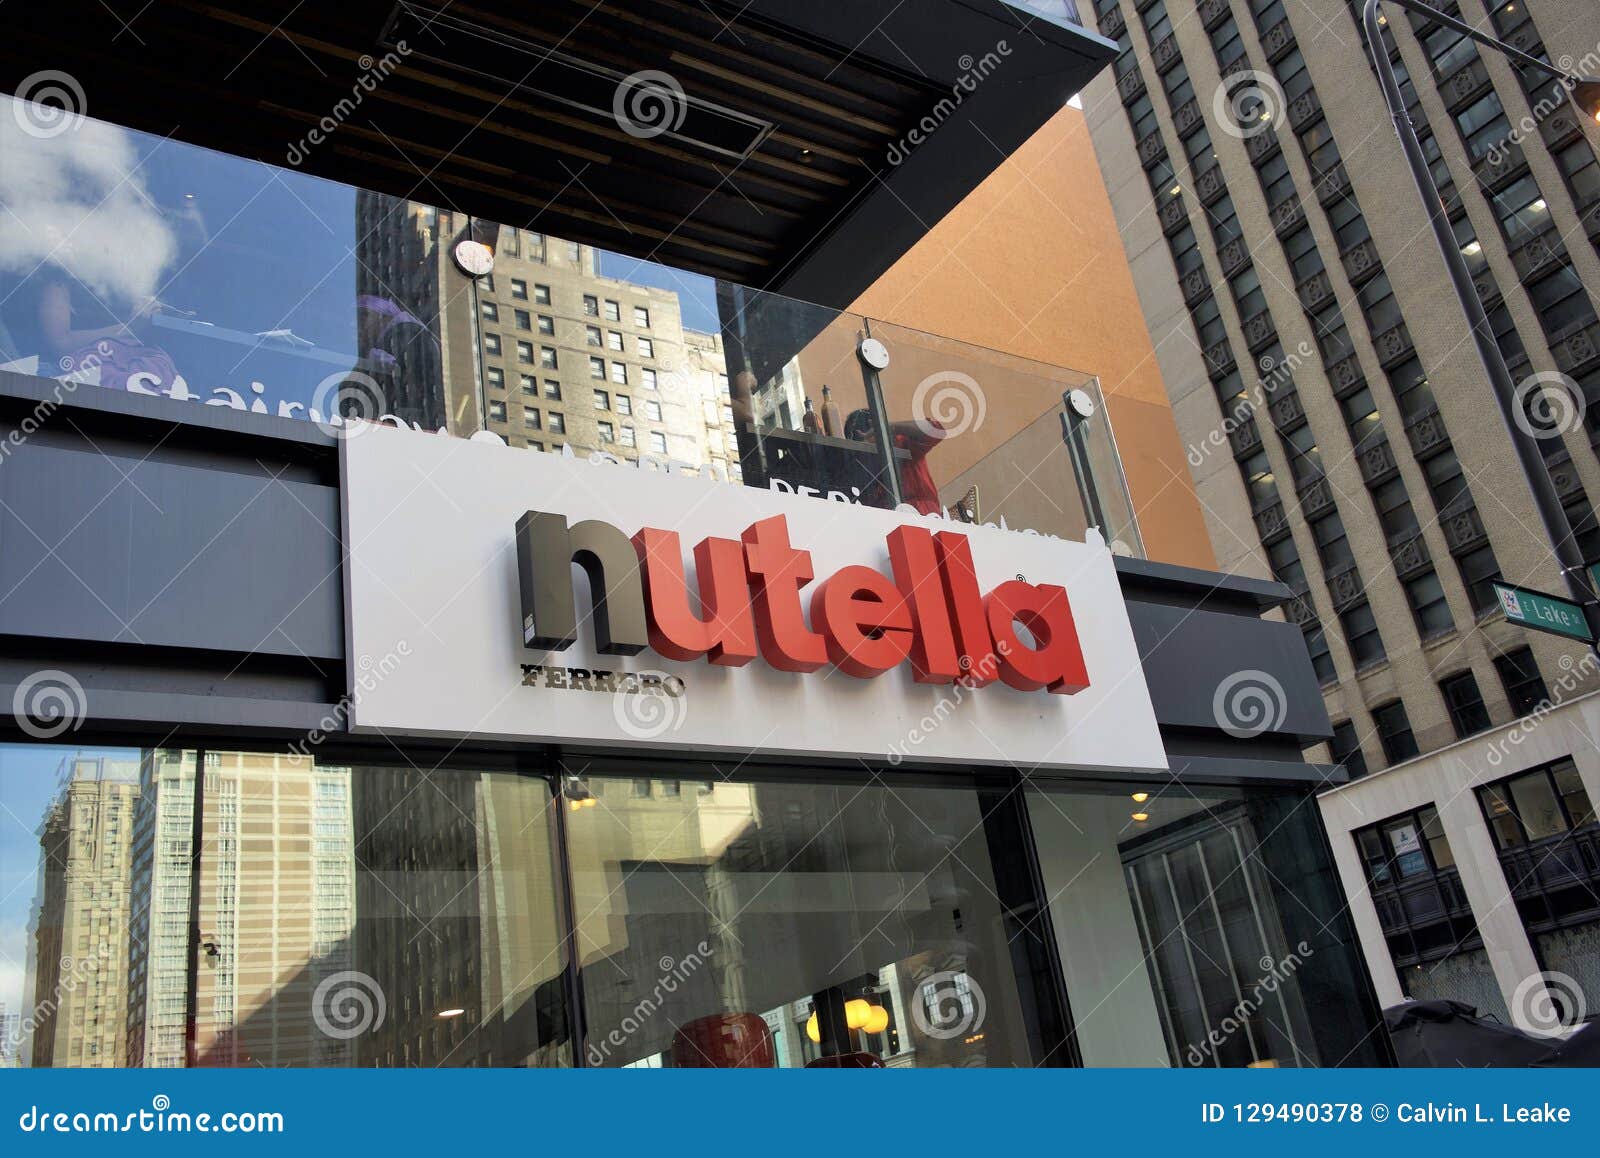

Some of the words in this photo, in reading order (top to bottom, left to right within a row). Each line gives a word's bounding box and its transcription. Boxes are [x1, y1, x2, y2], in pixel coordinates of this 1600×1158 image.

[515, 509, 1091, 695] nutella
[1531, 599, 1570, 626] Lake
[520, 663, 687, 698] FERRERO
